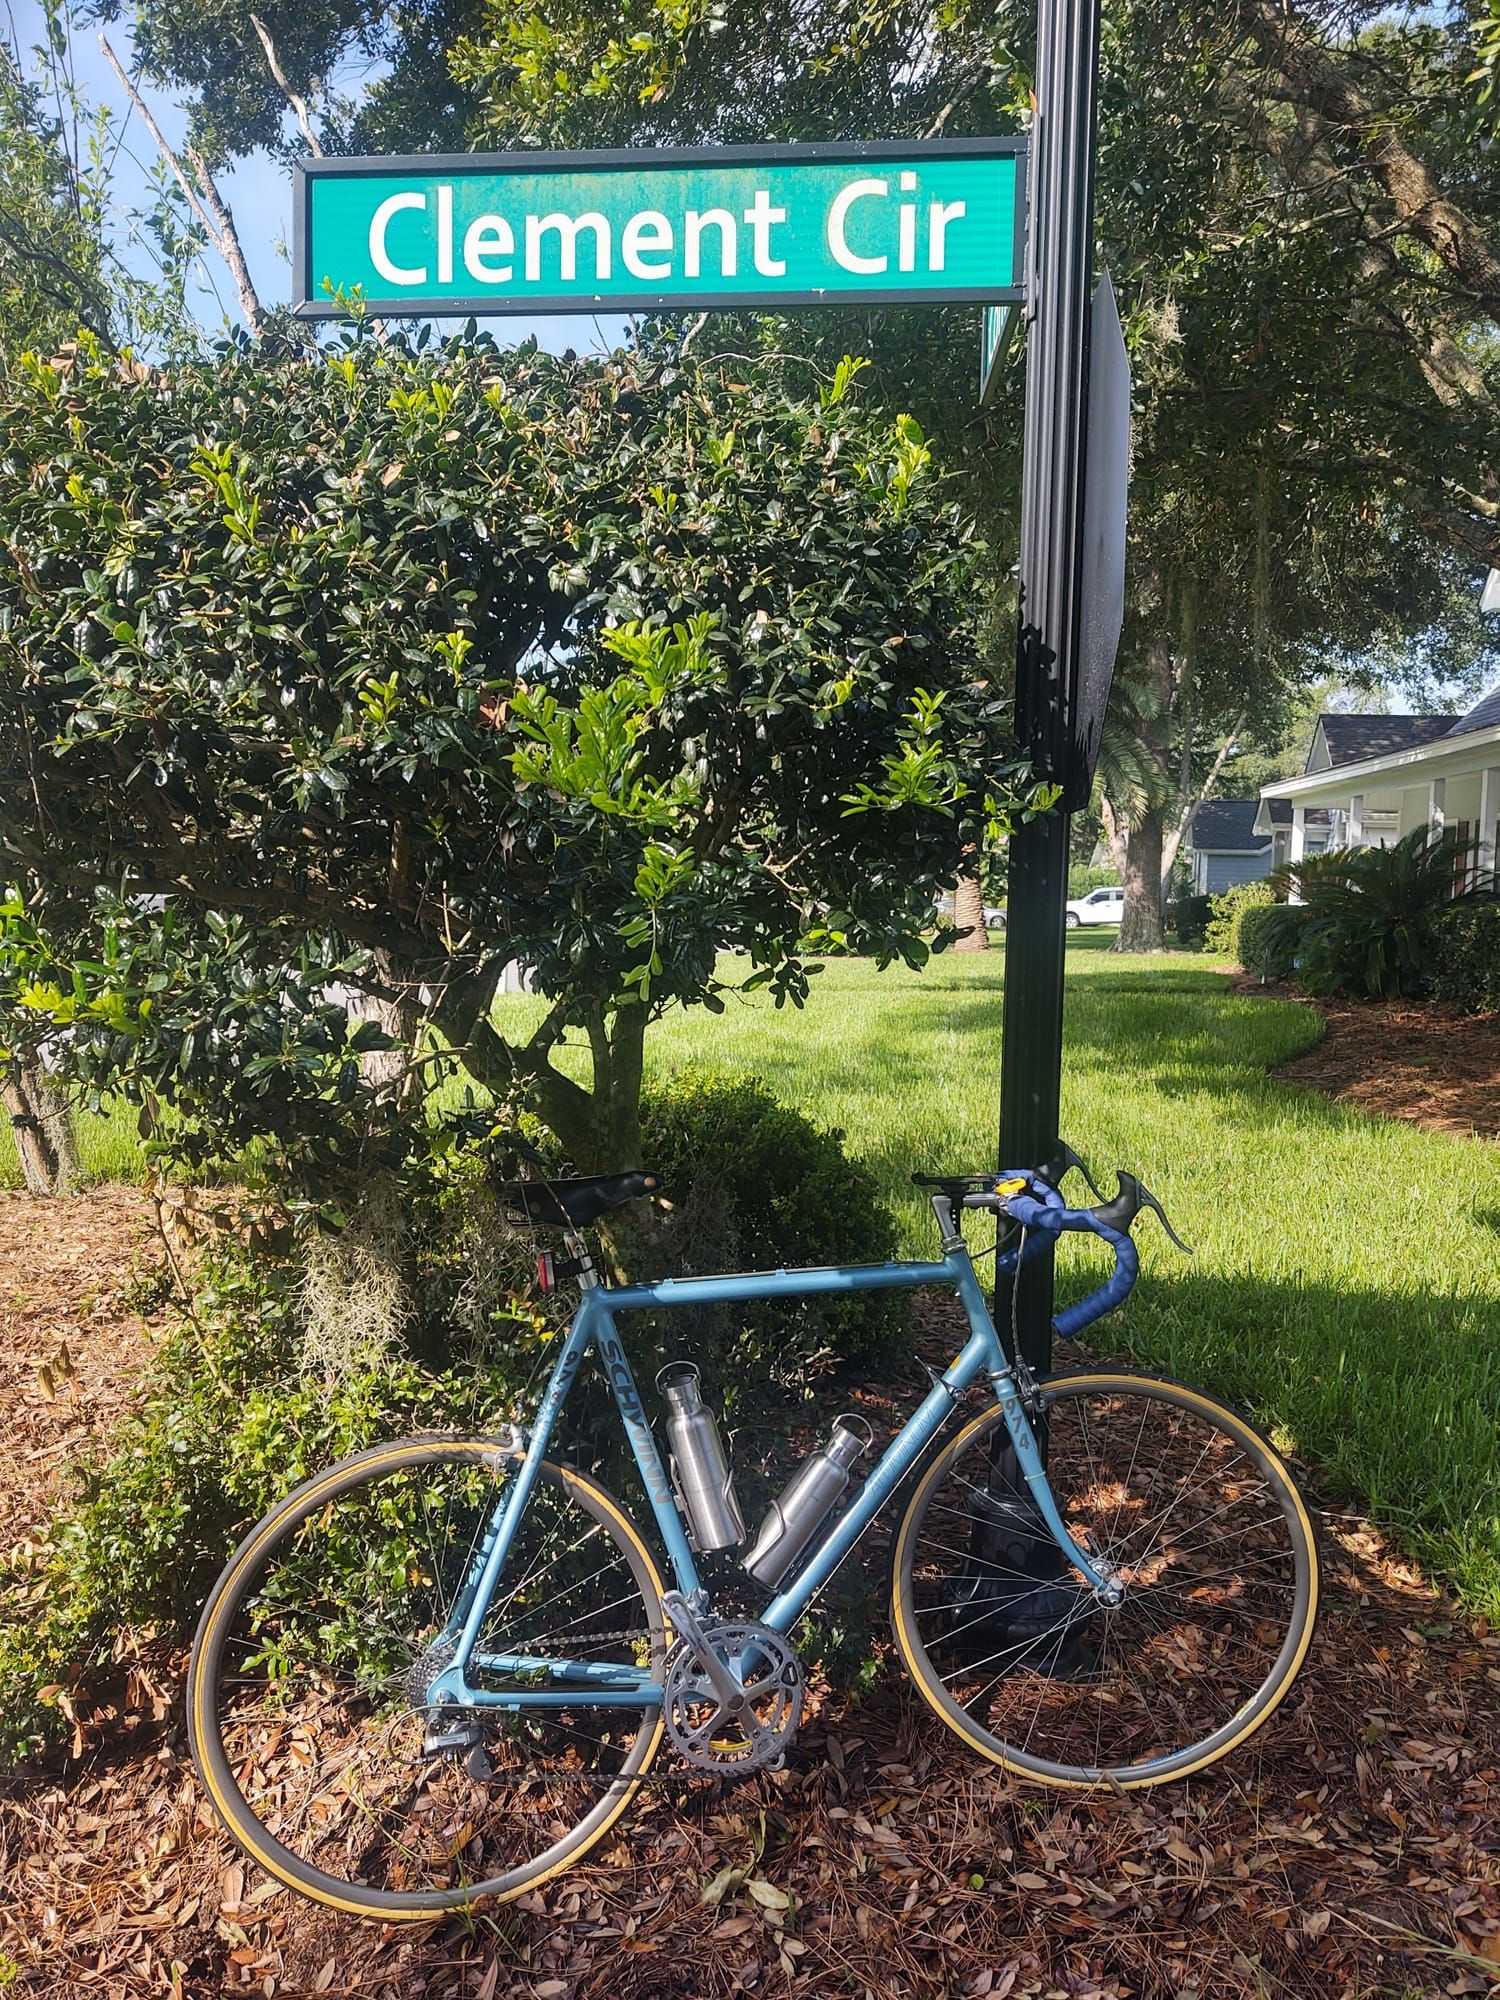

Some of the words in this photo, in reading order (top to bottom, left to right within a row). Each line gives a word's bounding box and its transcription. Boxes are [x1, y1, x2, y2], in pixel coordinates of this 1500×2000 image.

[368, 185, 787, 285] Clement
[828, 171, 966, 274] Cir
[600, 1339, 672, 1504] SCHWINN
[1006, 1399, 1030, 1450] 974
